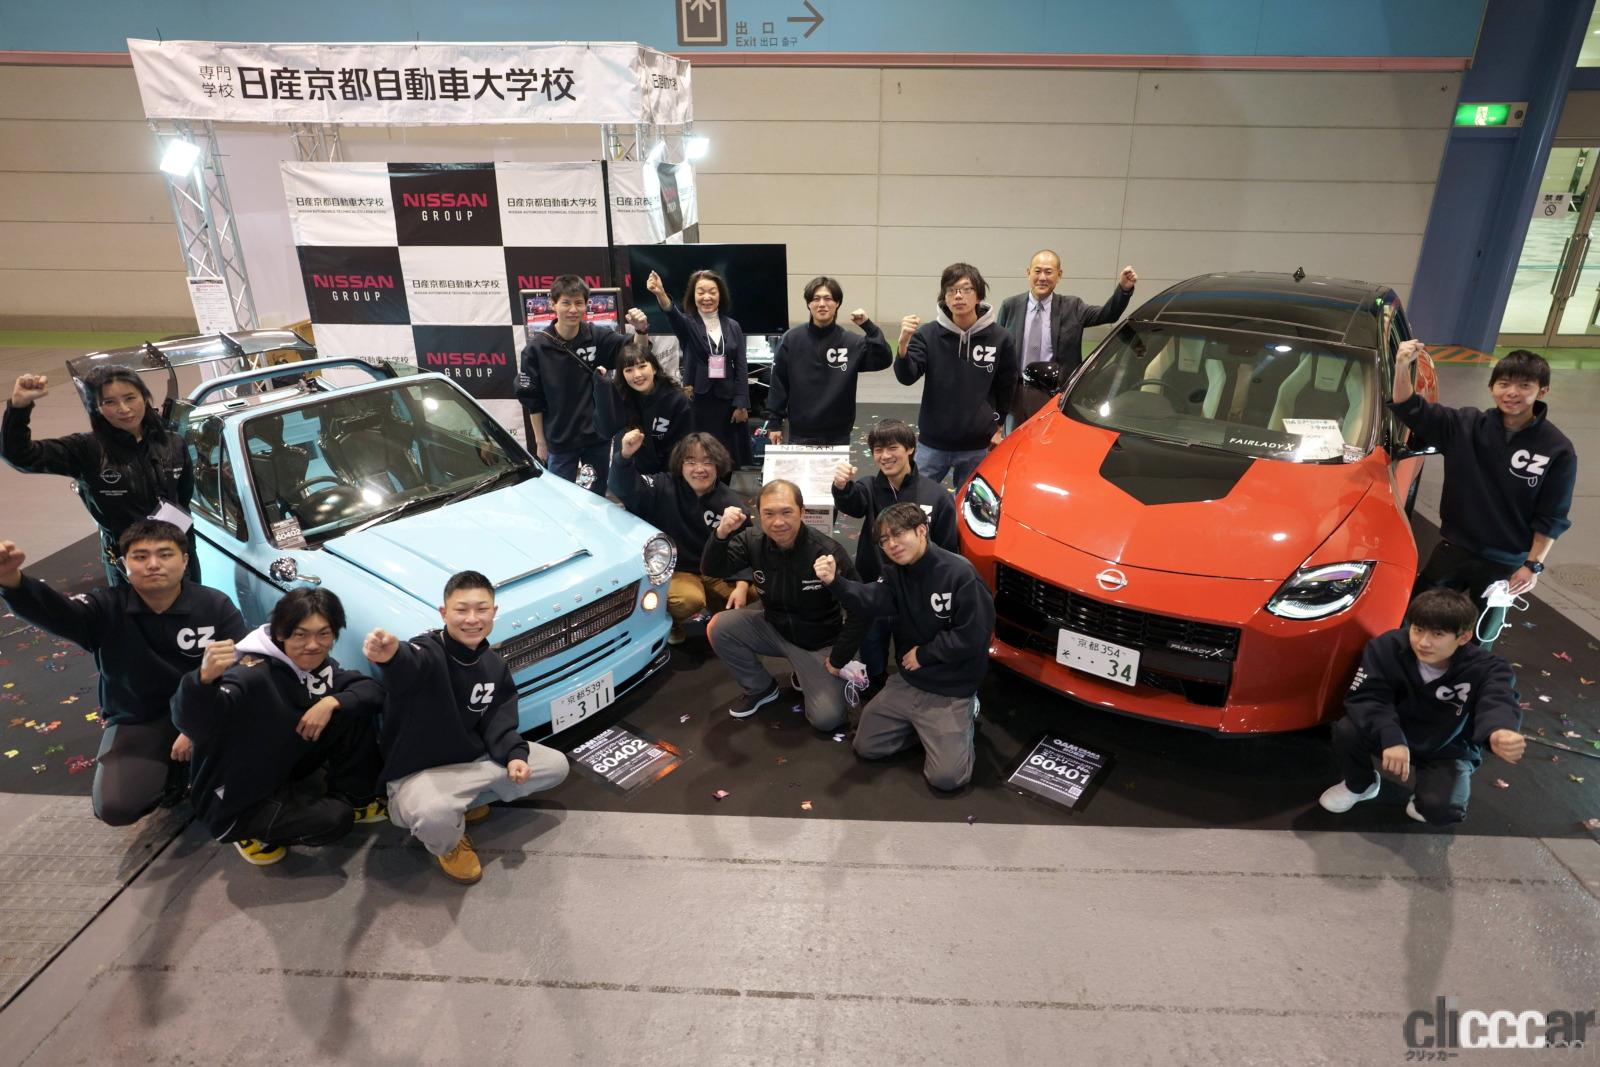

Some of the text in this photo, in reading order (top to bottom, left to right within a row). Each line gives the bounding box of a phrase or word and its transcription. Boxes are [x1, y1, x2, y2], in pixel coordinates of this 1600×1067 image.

[735, 21, 774, 35] 出口
[736, 36, 757, 47] Exit
[760, 37, 778, 47] 出口
[199, 65, 231, 81] 専門
[201, 83, 235, 98] 学校
[237, 66, 577, 101] 日産京都自動車大学校
[296, 197, 385, 207] 日産京都自動車大学校
[402, 193, 488, 208] NISSAN
[507, 197, 598, 208] 日産京都自動車大学校
[422, 210, 473, 221] GROUP
[313, 274, 395, 289] NISSAN
[412, 279, 500, 289] 日産京都自動車大学校
[332, 291, 381, 302] GROUP
[426, 352, 507, 366] NISSAN
[826, 348, 848, 363] CZ
[972, 345, 997, 362] CZ
[444, 367, 493, 378] GROUP
[1229, 438, 1283, 449] FAIRLADY
[1511, 449, 1550, 476] CZ
[177, 625, 216, 650] CZ
[470, 683, 495, 704] CZ
[593, 739, 648, 773] 60402
[1030, 754, 1090, 784] 60401
